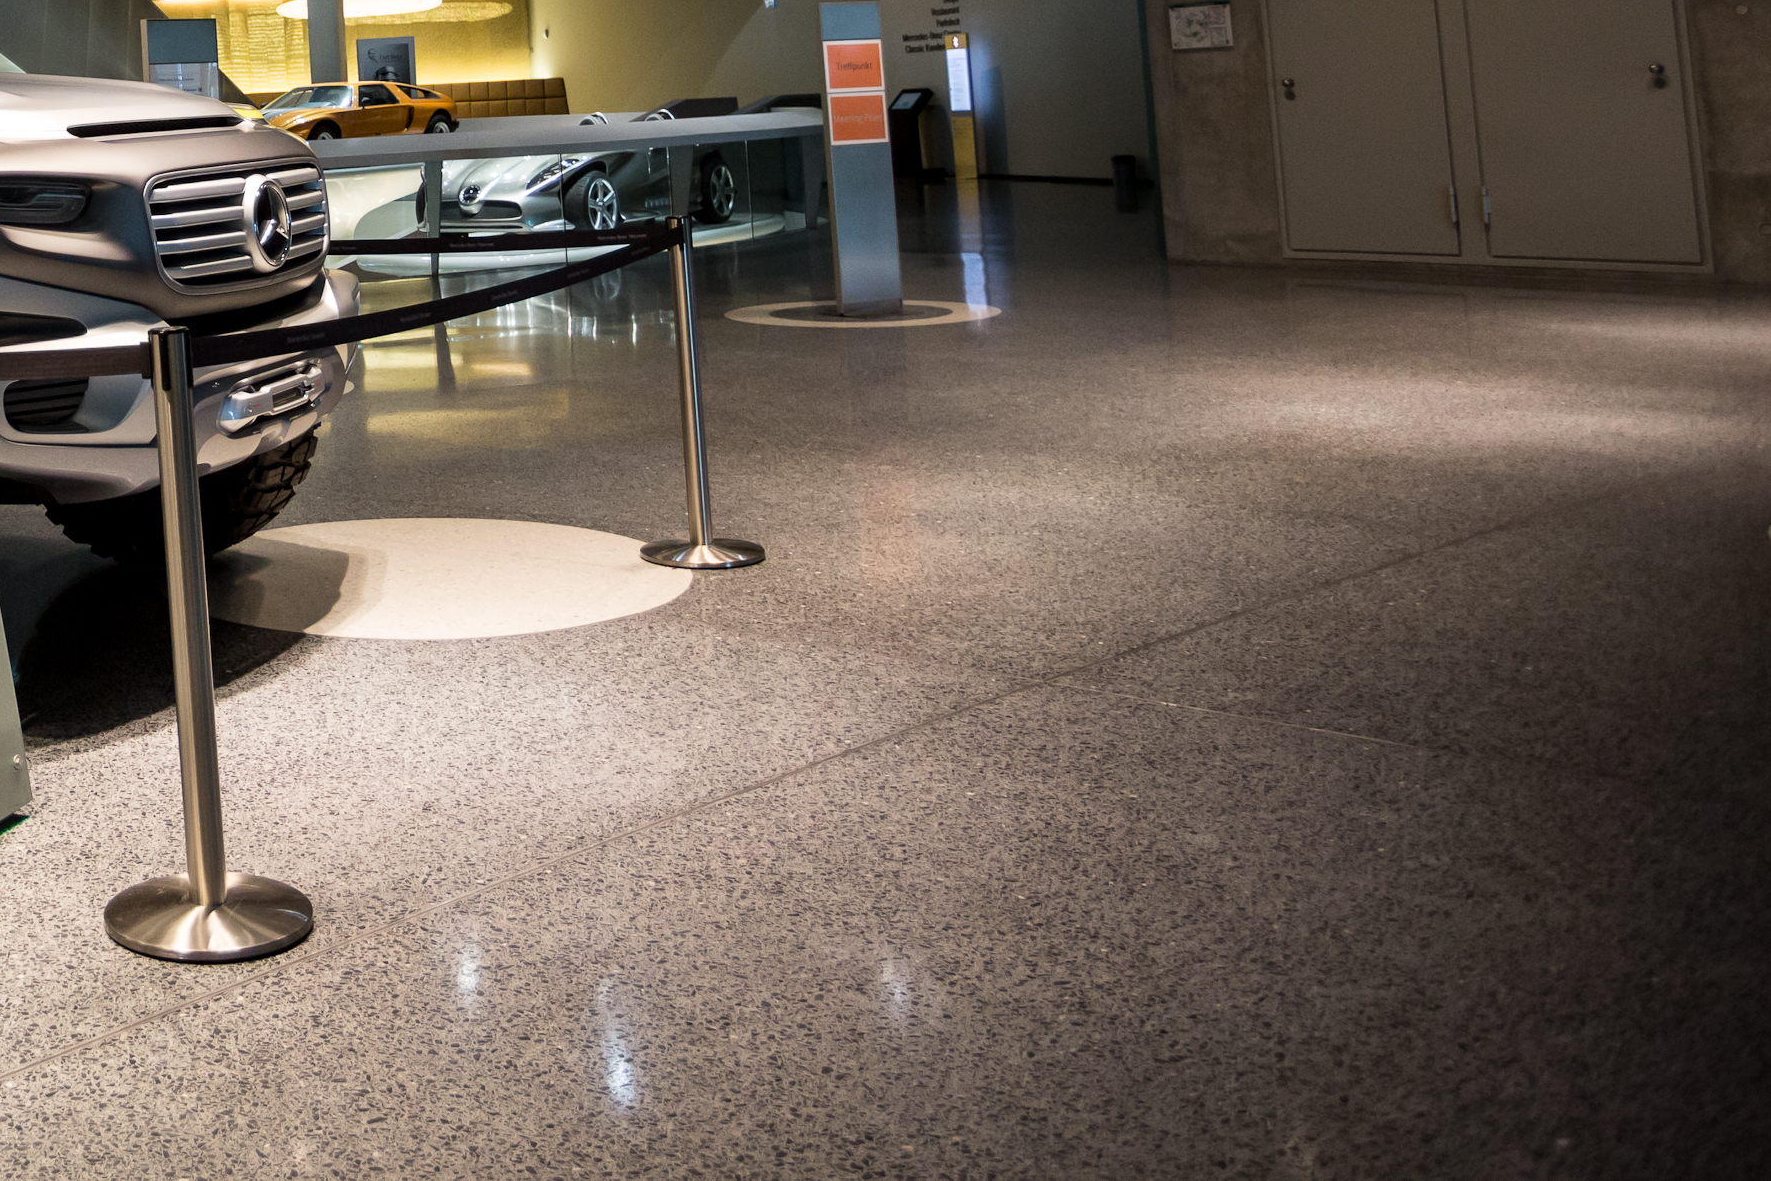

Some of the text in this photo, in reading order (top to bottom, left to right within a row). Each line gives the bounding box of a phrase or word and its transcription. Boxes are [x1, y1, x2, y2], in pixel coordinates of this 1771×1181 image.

[836, 61, 873, 72] Treffpunkt
[833, 112, 883, 124] Meeting Point
